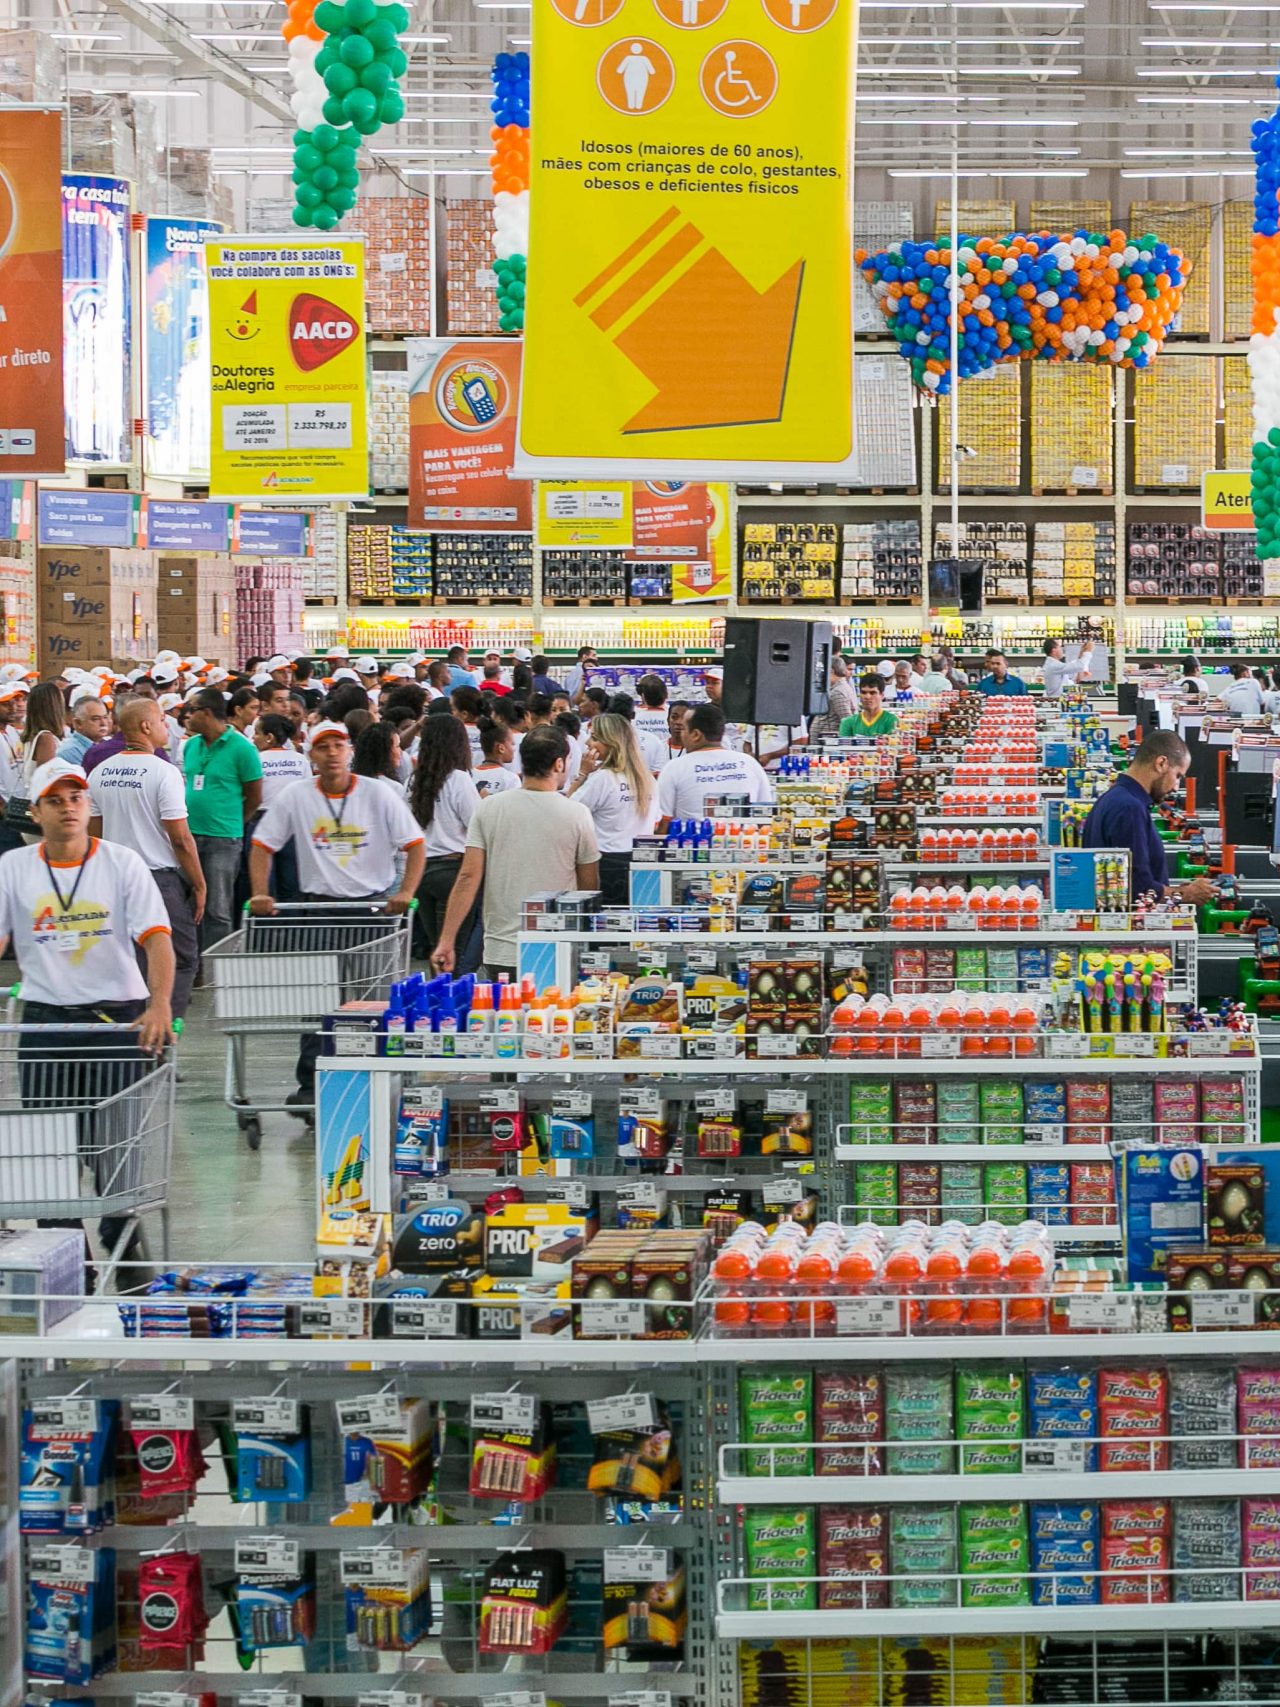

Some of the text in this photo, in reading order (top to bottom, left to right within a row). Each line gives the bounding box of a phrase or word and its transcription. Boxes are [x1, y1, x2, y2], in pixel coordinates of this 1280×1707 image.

[581, 140, 804, 161] Idosos (maiores de 60 anos),
[541, 157, 842, 179] mães com crianças de colo, gestantes,
[584, 177, 799, 195] obesos e deficientes físicos
[223, 249, 341, 262] Na compra das sacolas
[211, 266, 233, 278] você
[236, 266, 281, 277] colabora
[284, 267, 305, 277] com
[308, 267, 320, 277] as
[293, 321, 353, 339] AACD
[11, 347, 51, 366] direto
[212, 365, 275, 376] Doutores
[424, 443, 504, 460] MAIS VANTAGEM
[424, 461, 451, 472] PARA
[419, 1237, 456, 1250] zero
[488, 1228, 530, 1254] PRO
[752, 1389, 803, 1402] Trident
[823, 1389, 877, 1402] Trident
[966, 1389, 1018, 1401] Trident
[1036, 1386, 1088, 1400] Trident
[1106, 1383, 1158, 1400] Trident
[753, 1422, 804, 1434] Trident
[823, 1421, 876, 1434] Trident
[966, 1421, 1017, 1434] Trident
[1036, 1418, 1089, 1432] Trident
[1108, 1416, 1159, 1430] Trident
[968, 1517, 1019, 1529] Trident
[1038, 1519, 1089, 1533] Trident
[755, 1526, 805, 1541] Trident
[969, 1550, 1020, 1562] Trident
[1041, 1550, 1092, 1563] Trident
[490, 1578, 540, 1589] FIAT LUX
